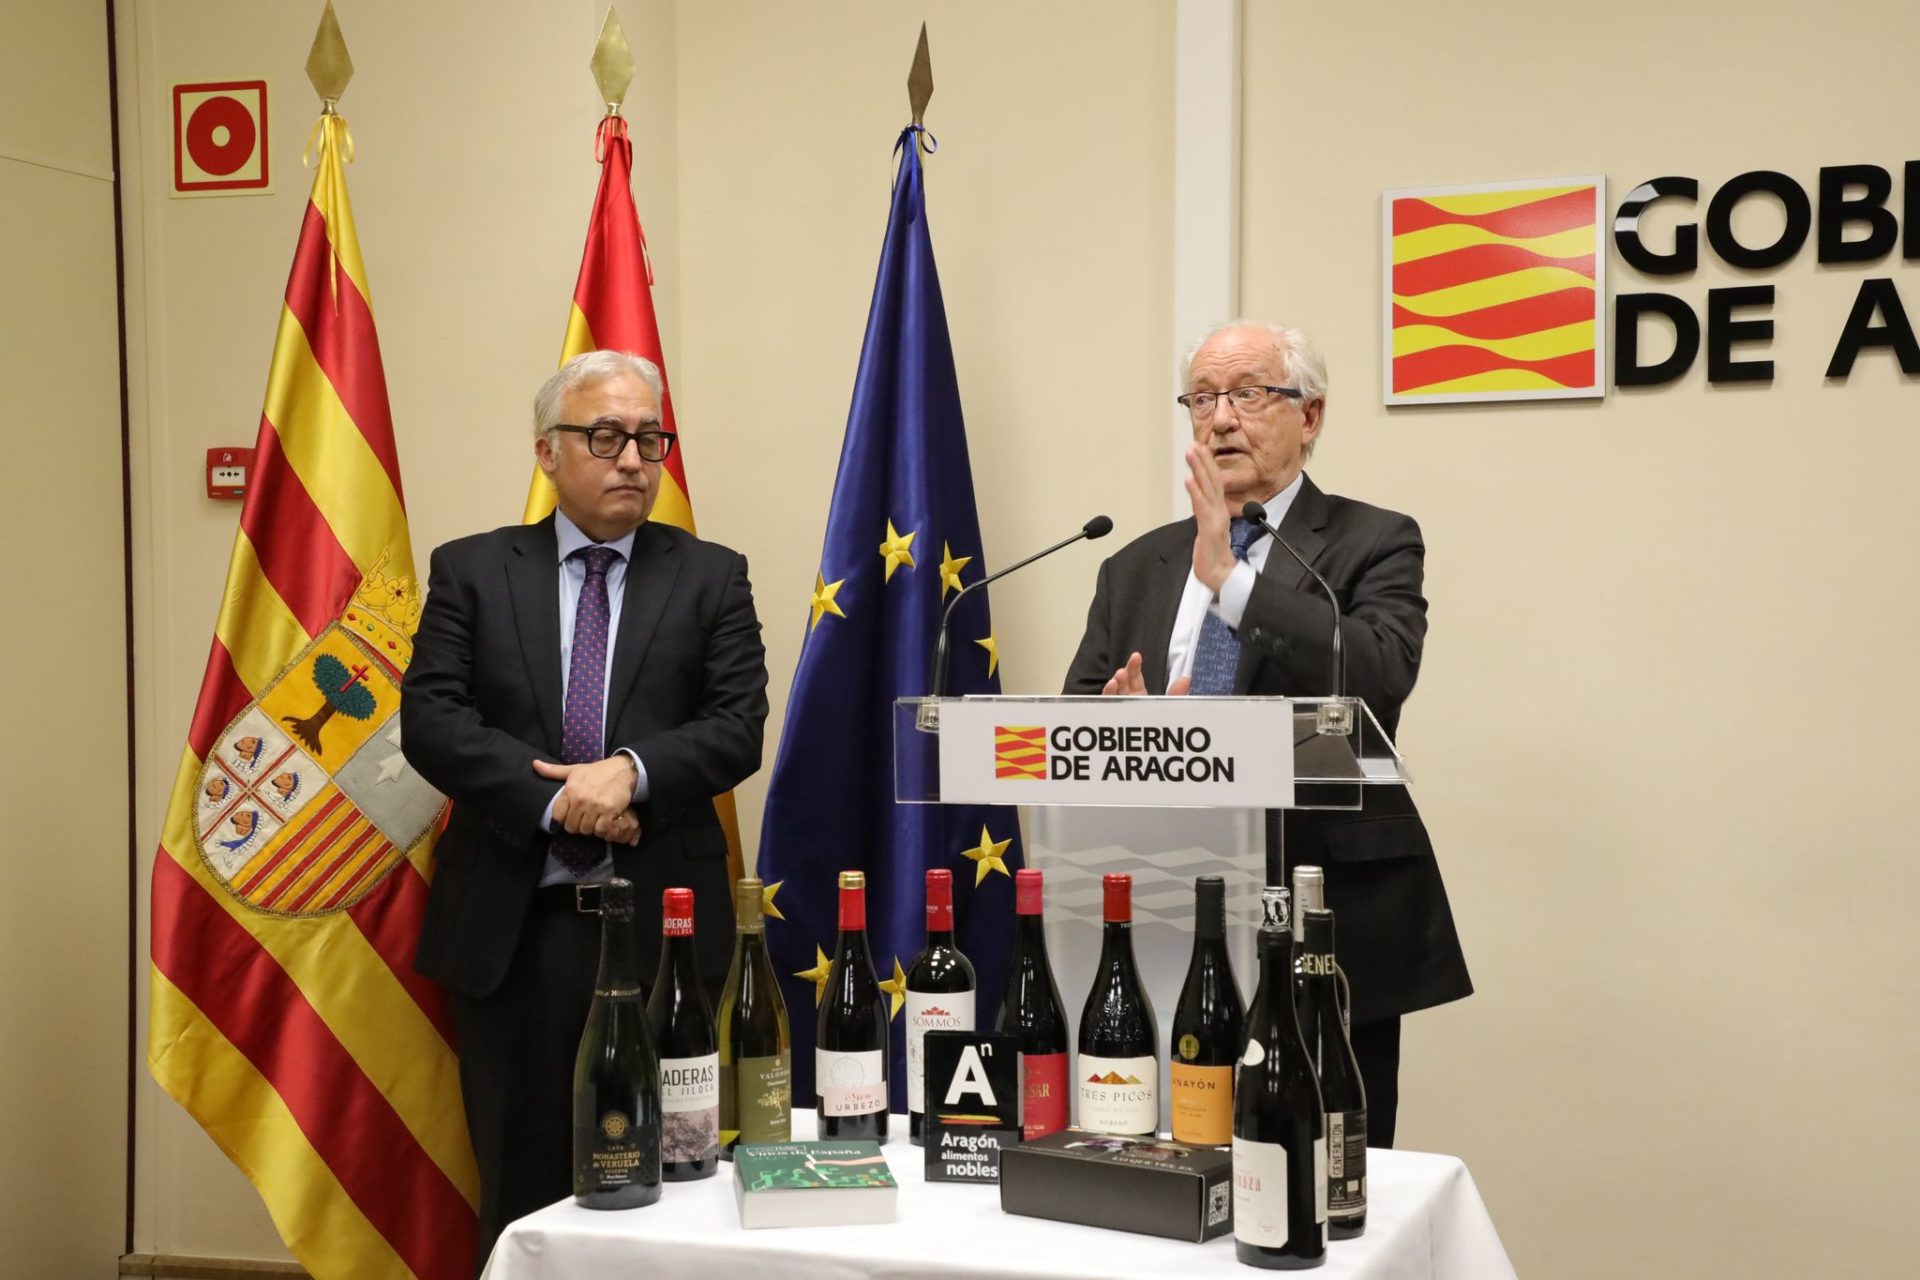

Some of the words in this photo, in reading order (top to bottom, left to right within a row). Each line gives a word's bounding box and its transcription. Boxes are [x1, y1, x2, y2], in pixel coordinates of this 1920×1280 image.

[1614, 285, 1775, 387] DE
[1050, 726, 1211, 753] GOBIERNO
[1050, 755, 1090, 781] DE
[1101, 755, 1235, 782] ARAGON
[912, 1016, 962, 1028] SOMMOS
[662, 1065, 714, 1087] ADERAS
[1080, 1087, 1106, 1101] TRES
[1113, 1089, 1153, 1102] PICOS
[835, 1099, 881, 1112] URBEZO
[941, 1149, 989, 1162] alimentos
[946, 1161, 999, 1178] nobles
